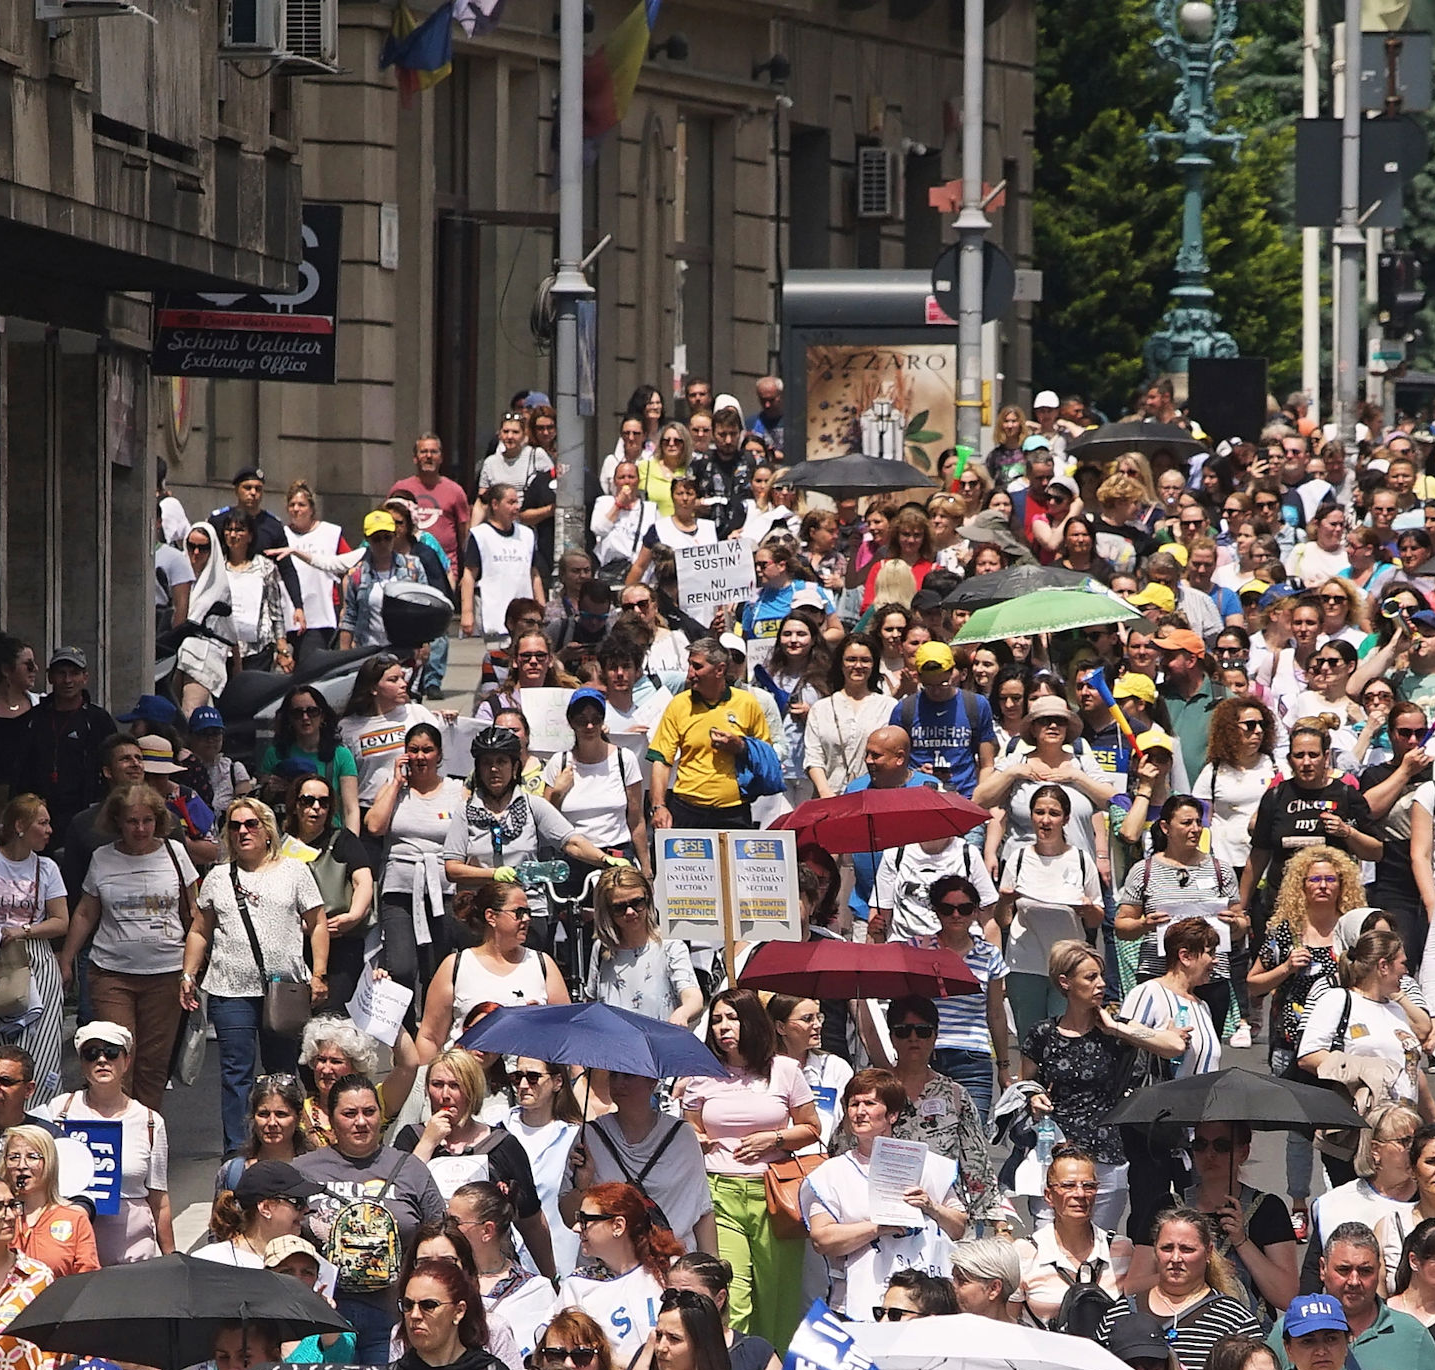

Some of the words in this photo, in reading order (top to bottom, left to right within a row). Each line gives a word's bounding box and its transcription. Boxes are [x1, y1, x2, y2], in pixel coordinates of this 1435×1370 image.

[167, 330, 240, 351] Schimb
[246, 333, 322, 355] Valutar
[181, 351, 256, 373] Exchange
[259, 355, 308, 375] Office
[816, 353, 947, 371] AZZARO
[682, 543, 720, 559] ELEVII
[711, 578, 726, 590] NU
[1295, 818, 1319, 832] my
[1301, 1301, 1332, 1318] FSLI
